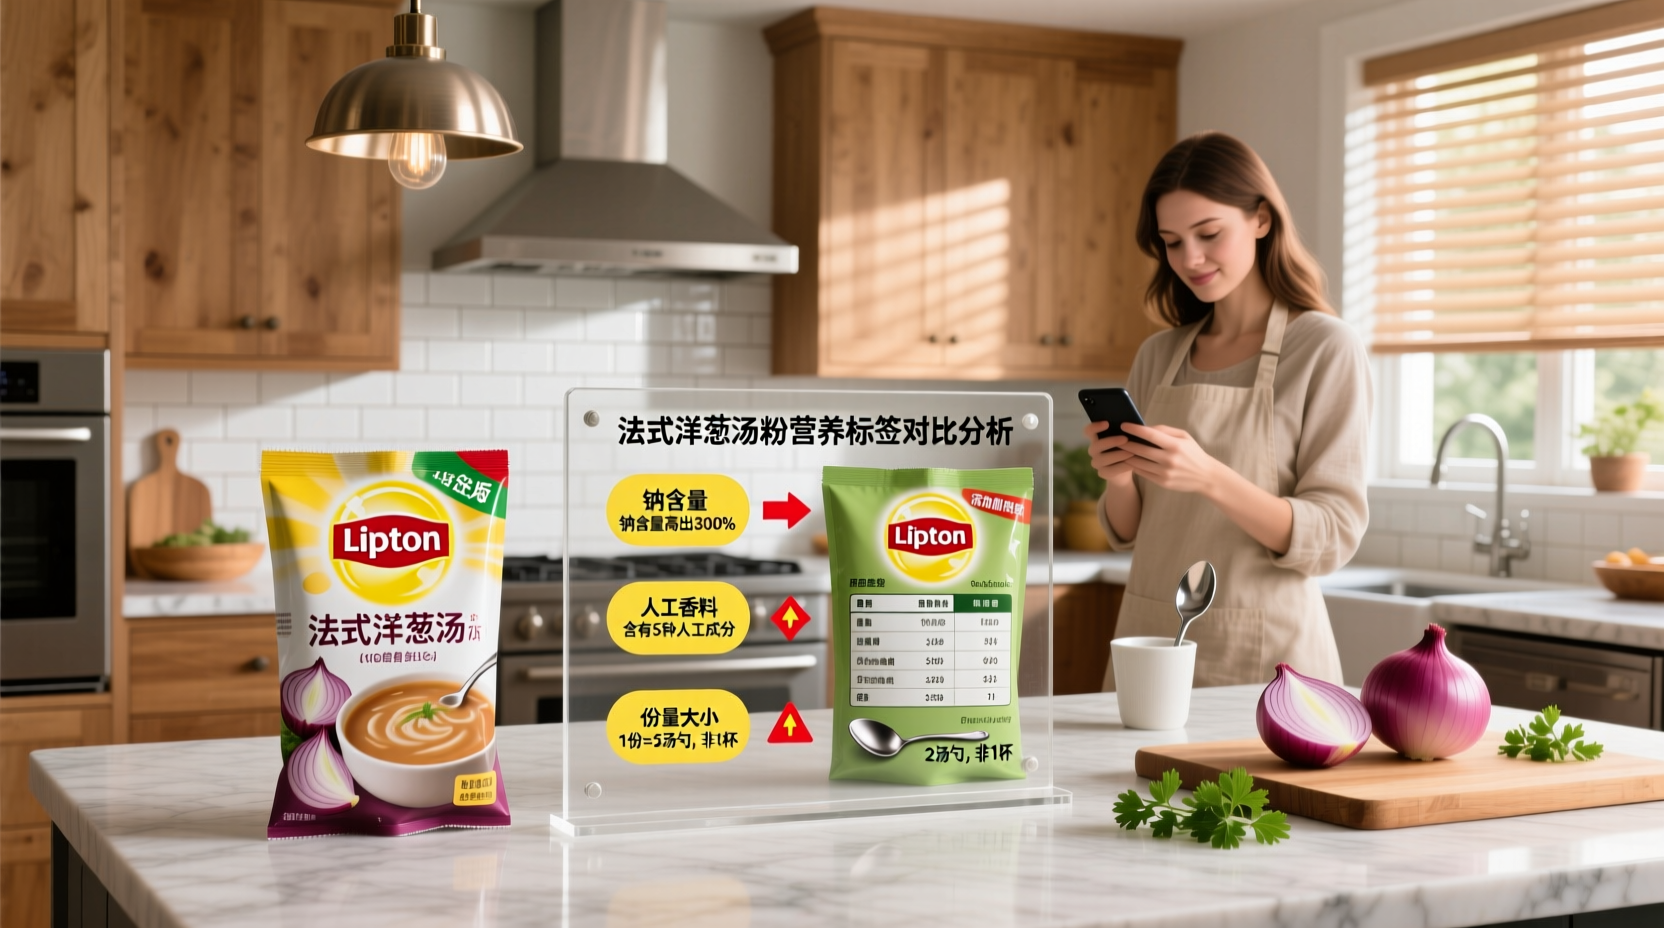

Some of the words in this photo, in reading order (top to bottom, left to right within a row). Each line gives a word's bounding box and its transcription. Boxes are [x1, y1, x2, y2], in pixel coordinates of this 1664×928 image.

[618, 414, 1014, 446] 法式洋葱汤粉营养标签对比分析
[642, 489, 708, 512] 钠含量
[618, 515, 736, 532] 钠含量高出300%
[343, 525, 442, 560] Lipton
[894, 525, 967, 550] Lipton
[640, 596, 718, 618] 人工香料
[308, 611, 465, 648] 法式洋葱汤
[623, 621, 736, 638] 含有5种人工成分
[640, 707, 719, 728] 份量大小
